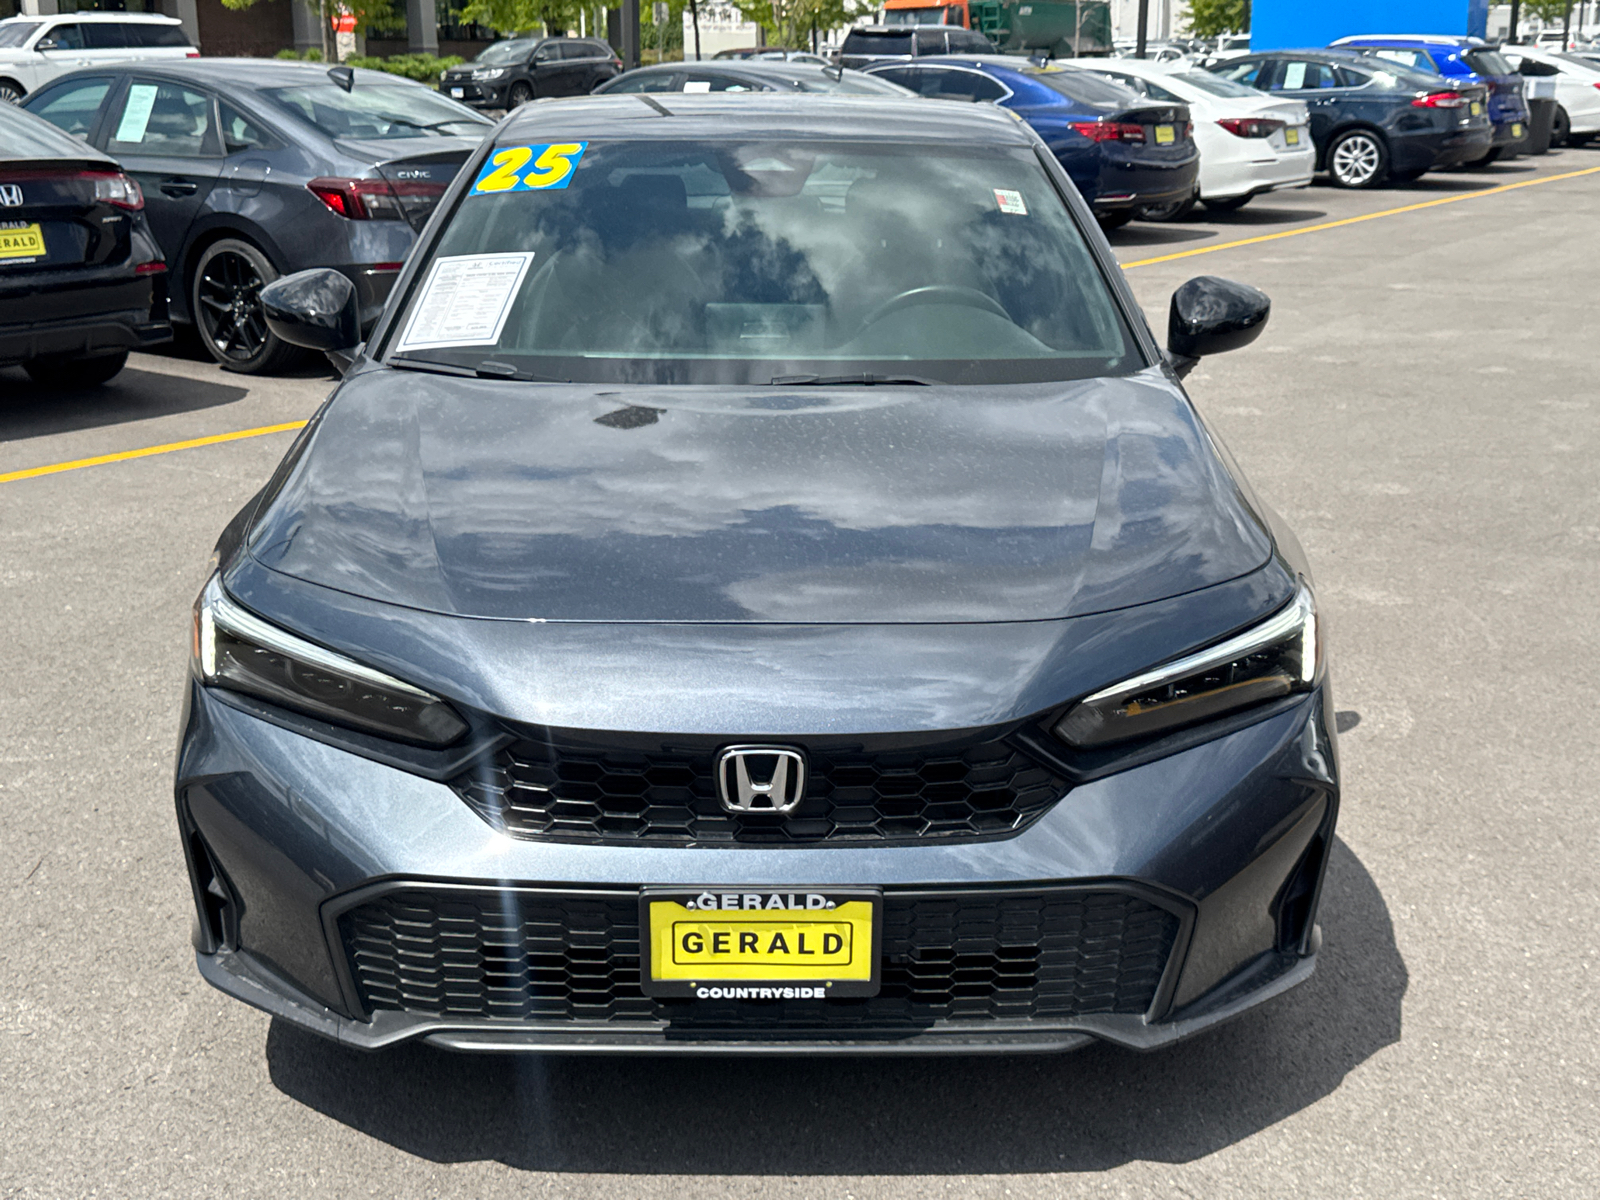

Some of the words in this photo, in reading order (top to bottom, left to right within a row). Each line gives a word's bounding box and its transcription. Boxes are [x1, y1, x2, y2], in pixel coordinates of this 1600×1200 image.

[397, 170, 431, 179] CIVIC
[476, 143, 582, 192] 25
[0, 221, 27, 230] RALD
[696, 893, 826, 911] GERALD
[682, 932, 843, 955] GERALD
[696, 987, 826, 999] COUNTRYSIDE
